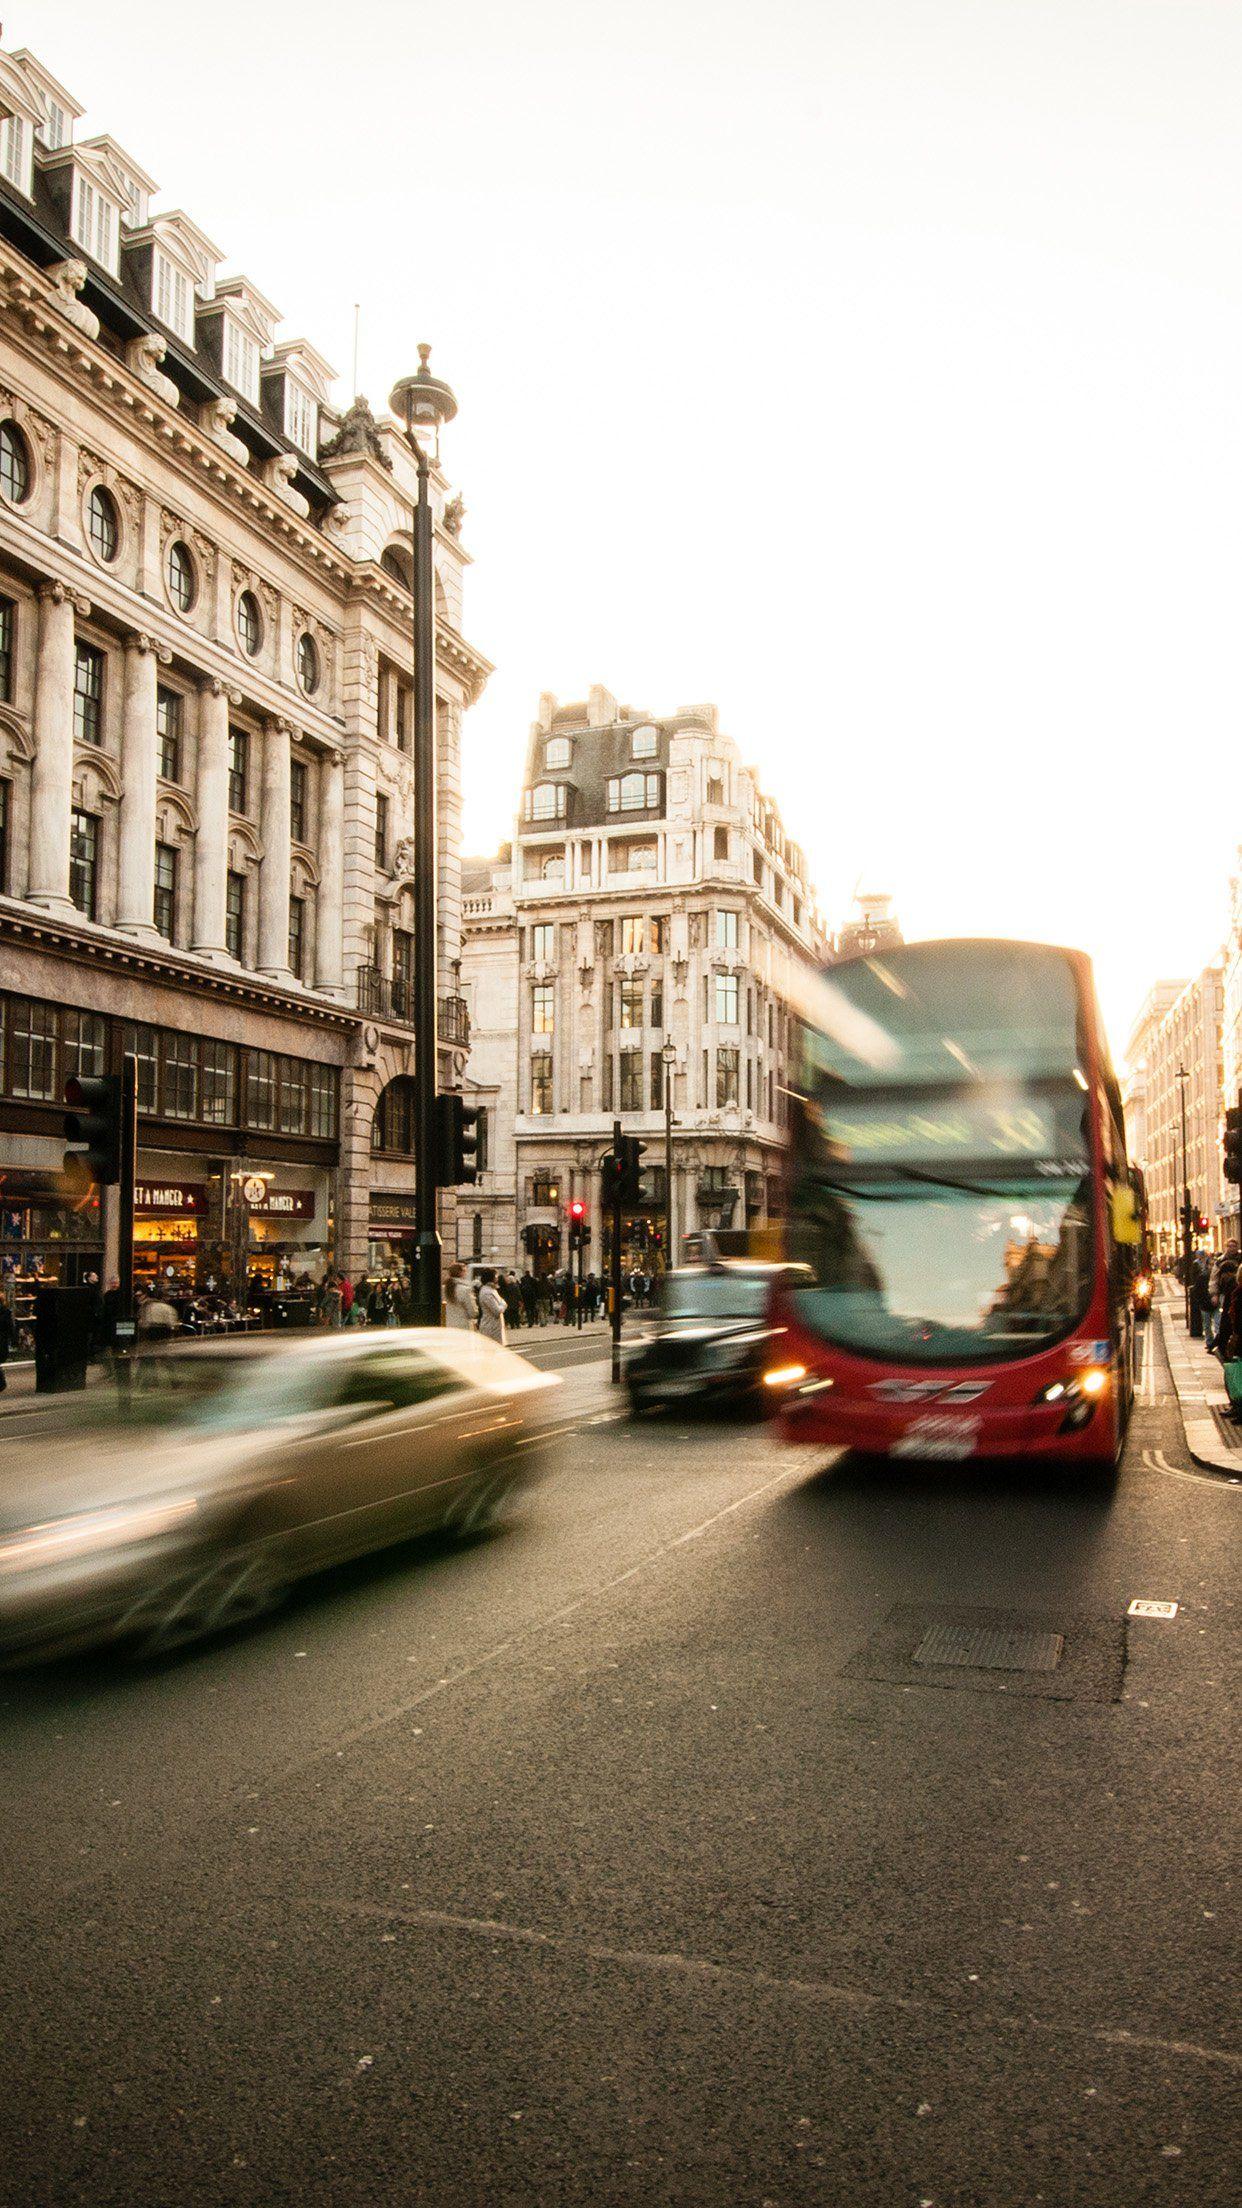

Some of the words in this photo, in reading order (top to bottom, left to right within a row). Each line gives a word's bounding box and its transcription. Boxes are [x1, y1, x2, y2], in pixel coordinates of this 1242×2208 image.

[153, 1189, 183, 1206] MANGER
[369, 1205, 400, 1218] ATISSERIE
[401, 1207, 416, 1219] VALE
